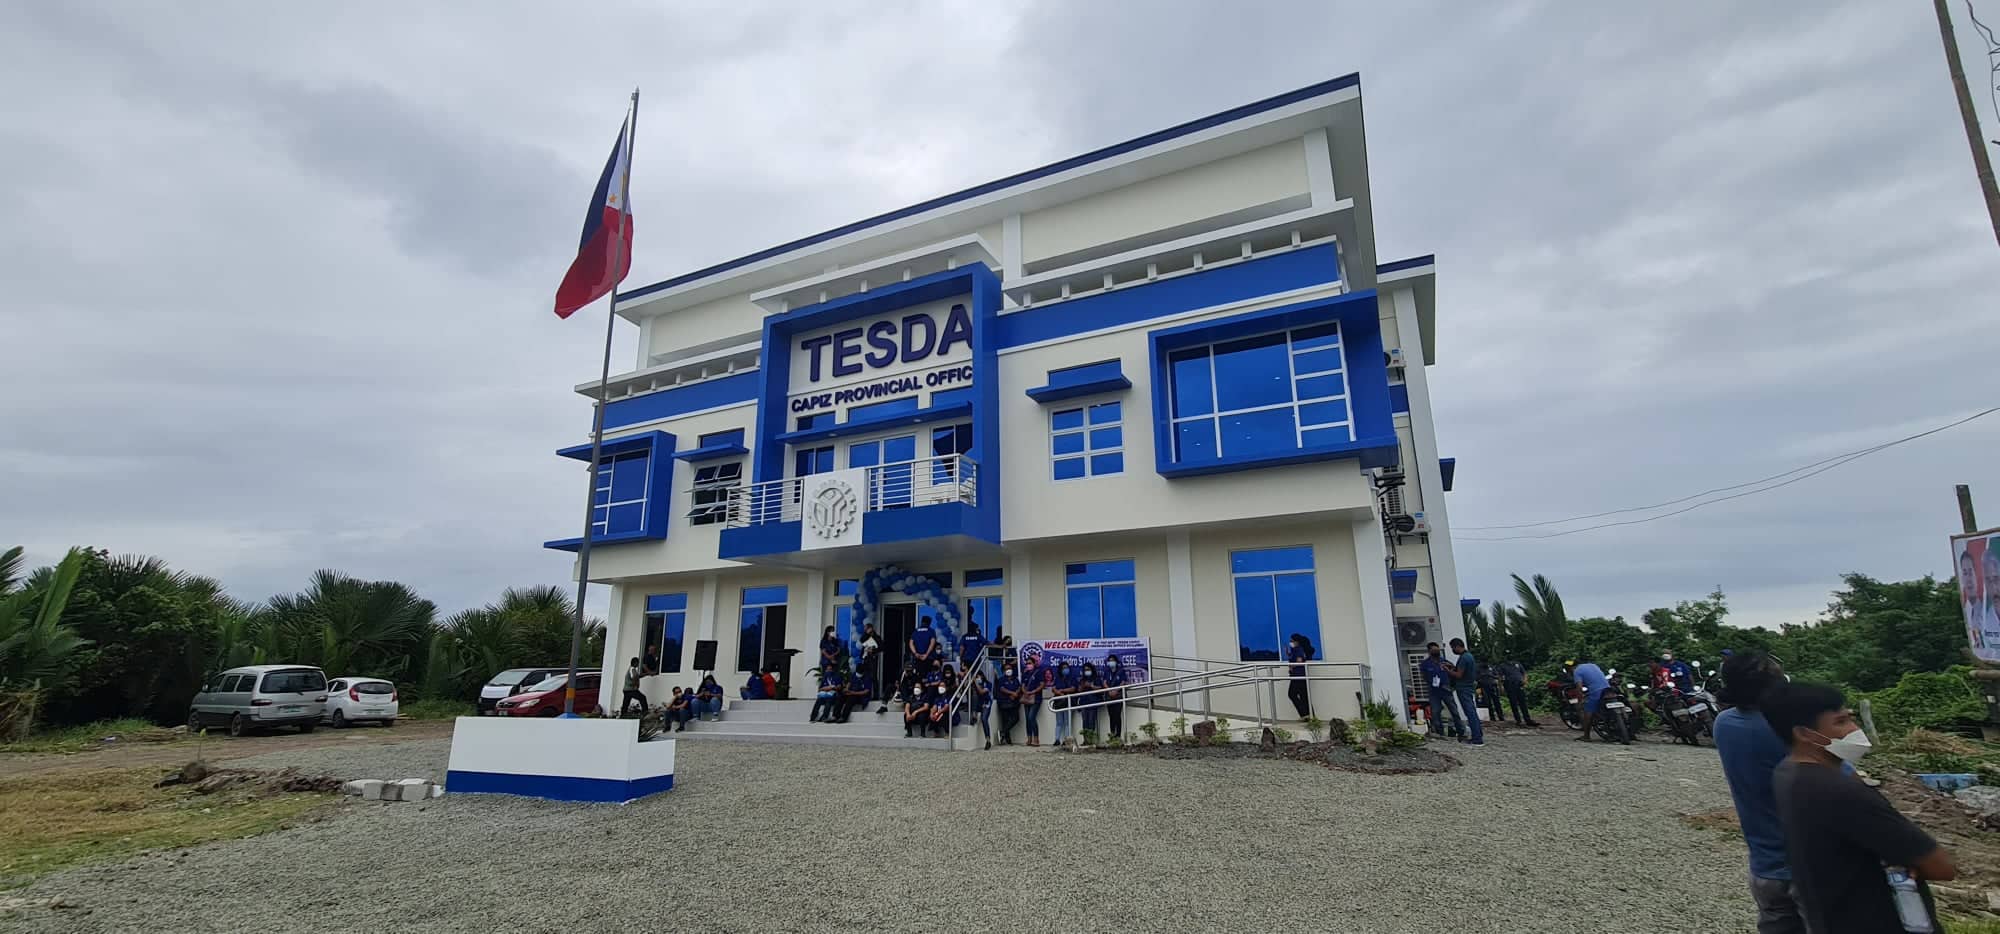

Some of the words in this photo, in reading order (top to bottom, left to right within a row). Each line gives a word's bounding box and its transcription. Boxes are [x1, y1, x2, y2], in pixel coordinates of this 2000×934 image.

[801, 304, 973, 382] TESDA
[791, 393, 832, 412] CAPIZ
[835, 376, 923, 405] PROVINCIAL
[926, 365, 973, 387] OFFIC
[1044, 640, 1090, 649] WELCOME!
